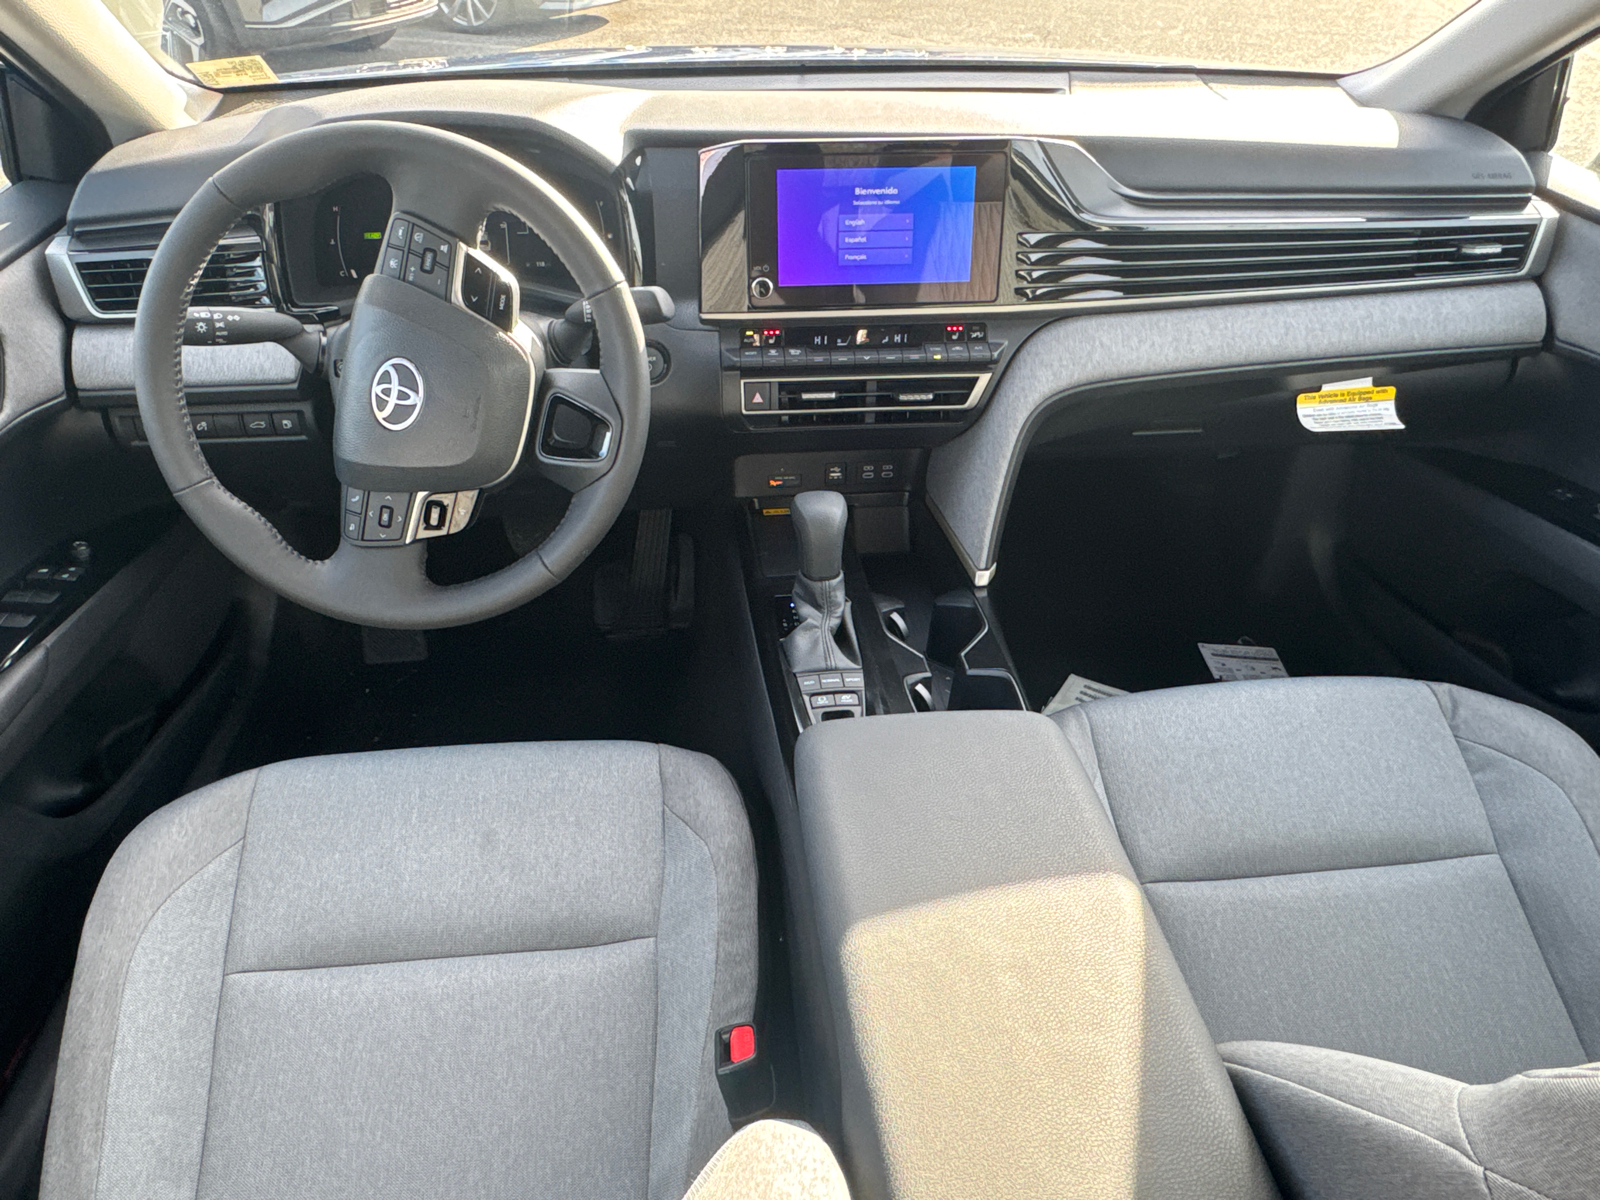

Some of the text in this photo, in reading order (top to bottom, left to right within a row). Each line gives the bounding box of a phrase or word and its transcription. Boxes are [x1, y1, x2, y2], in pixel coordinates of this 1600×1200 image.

[854, 186, 899, 195] Bienvenido
[845, 219, 865, 227] English
[845, 236, 867, 244] Español
[1346, 390, 1374, 398] Equipped
[1357, 395, 1373, 403] Bags
